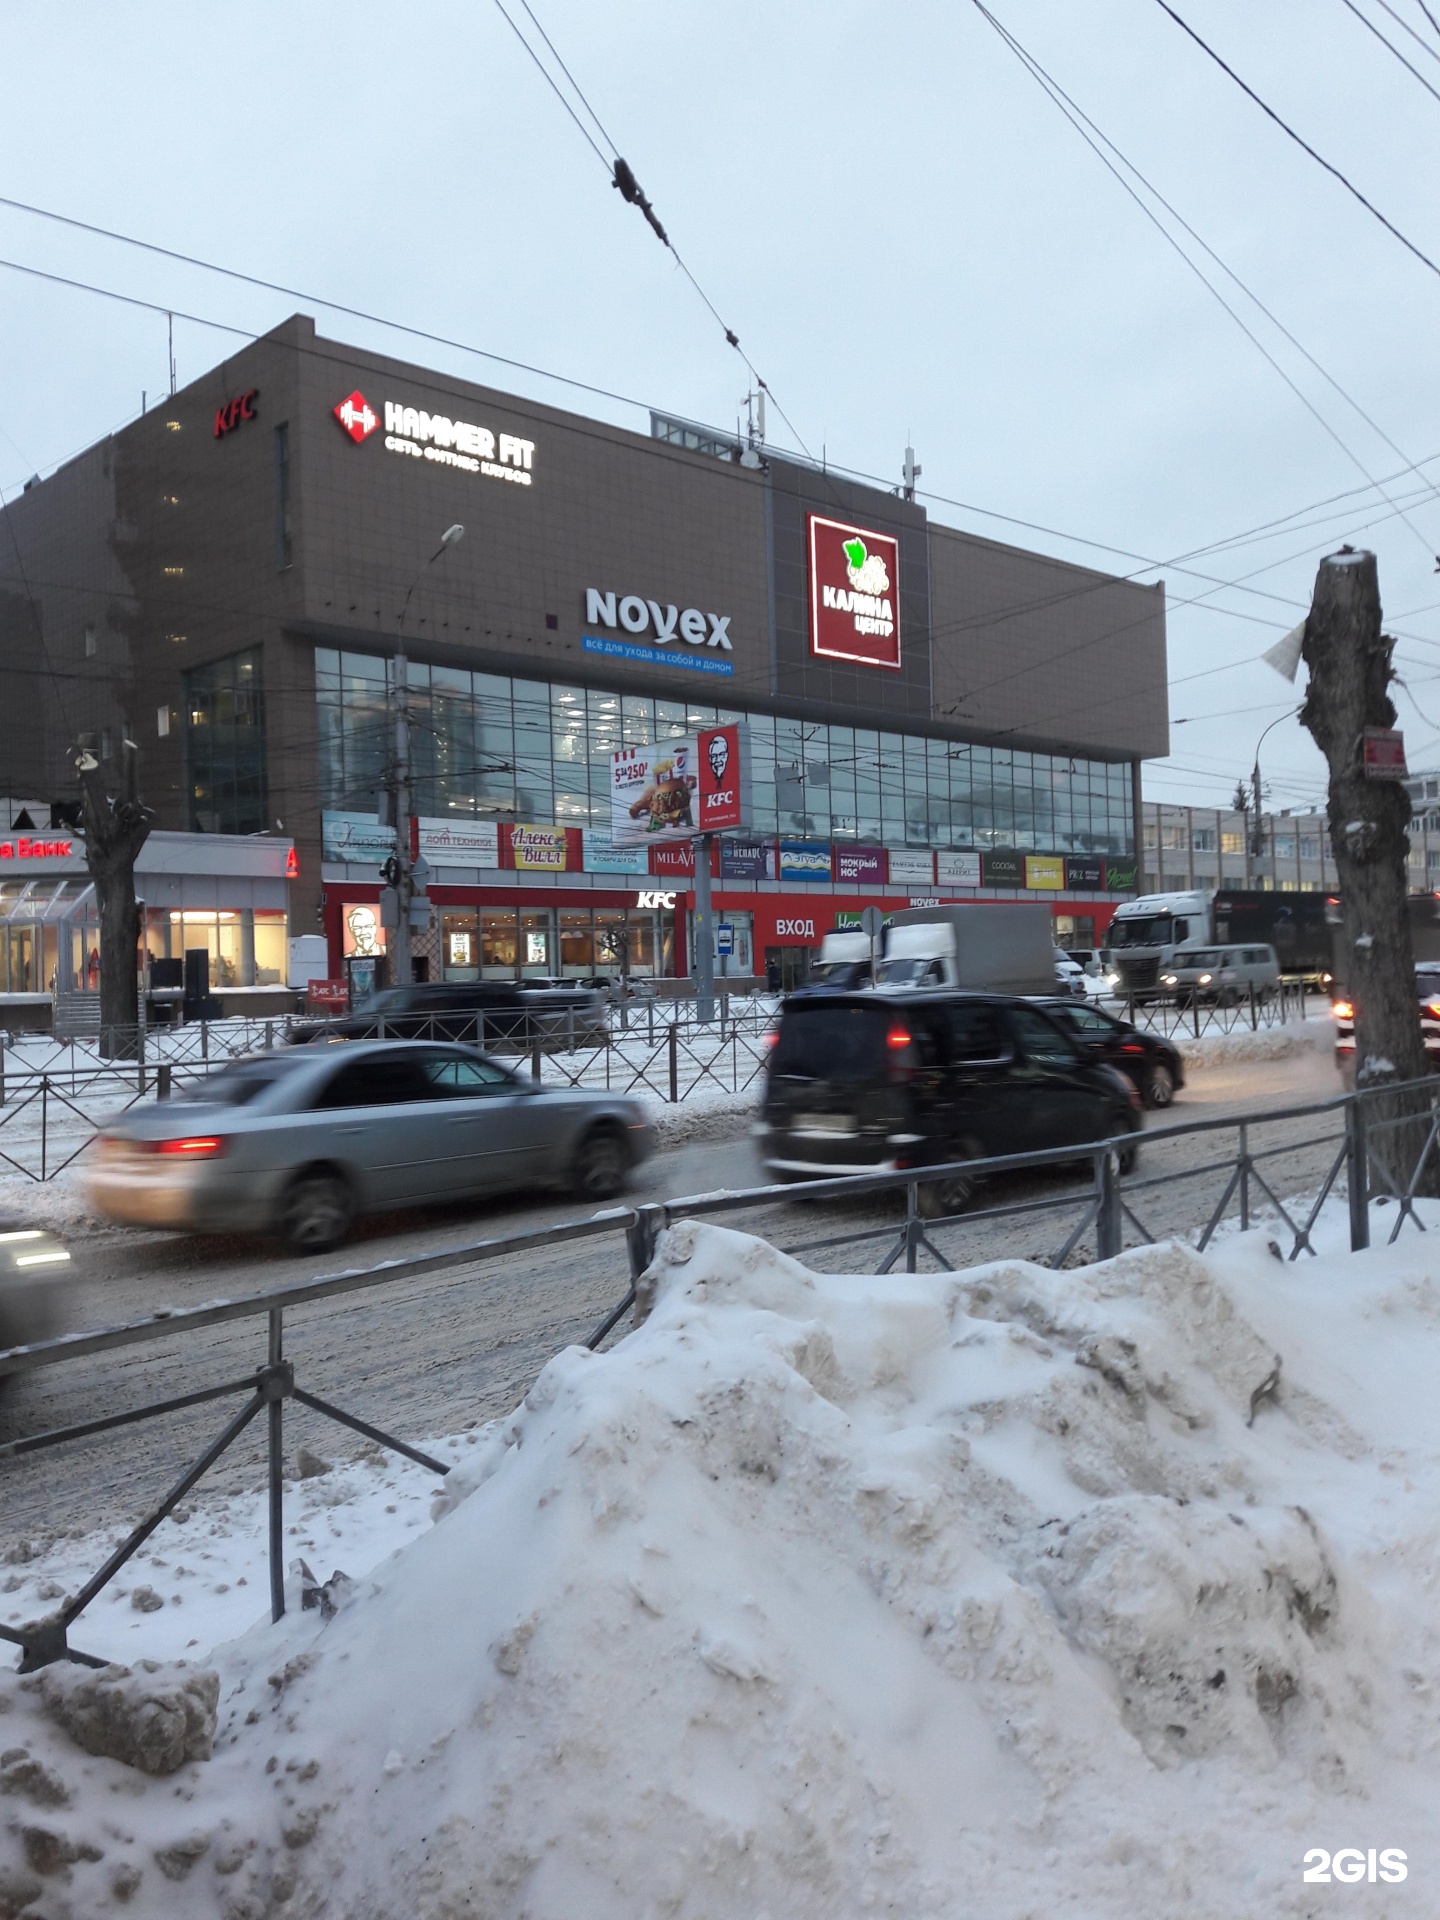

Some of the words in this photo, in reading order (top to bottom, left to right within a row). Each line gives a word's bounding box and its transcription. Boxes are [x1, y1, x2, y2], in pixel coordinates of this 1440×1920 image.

[214, 388, 257, 439] KFC
[384, 400, 495, 459] HAMMER
[499, 433, 535, 469] FIT
[384, 435, 423, 457] СЕТЬ
[823, 585, 893, 621] КАЛИНА
[855, 614, 894, 637] ЦЕНТР
[605, 642, 623, 654] для
[624, 646, 653, 659] ухода
[656, 652, 666, 661] за
[667, 653, 694, 666] собой
[703, 660, 732, 672] домом
[707, 790, 733, 808] KFC
[17, 837, 72, 859] Банк
[511, 828, 556, 847] Алекс
[1107, 865, 1138, 886] Ярче!
[636, 891, 677, 909] KFC
[776, 919, 815, 938] ВХОД
